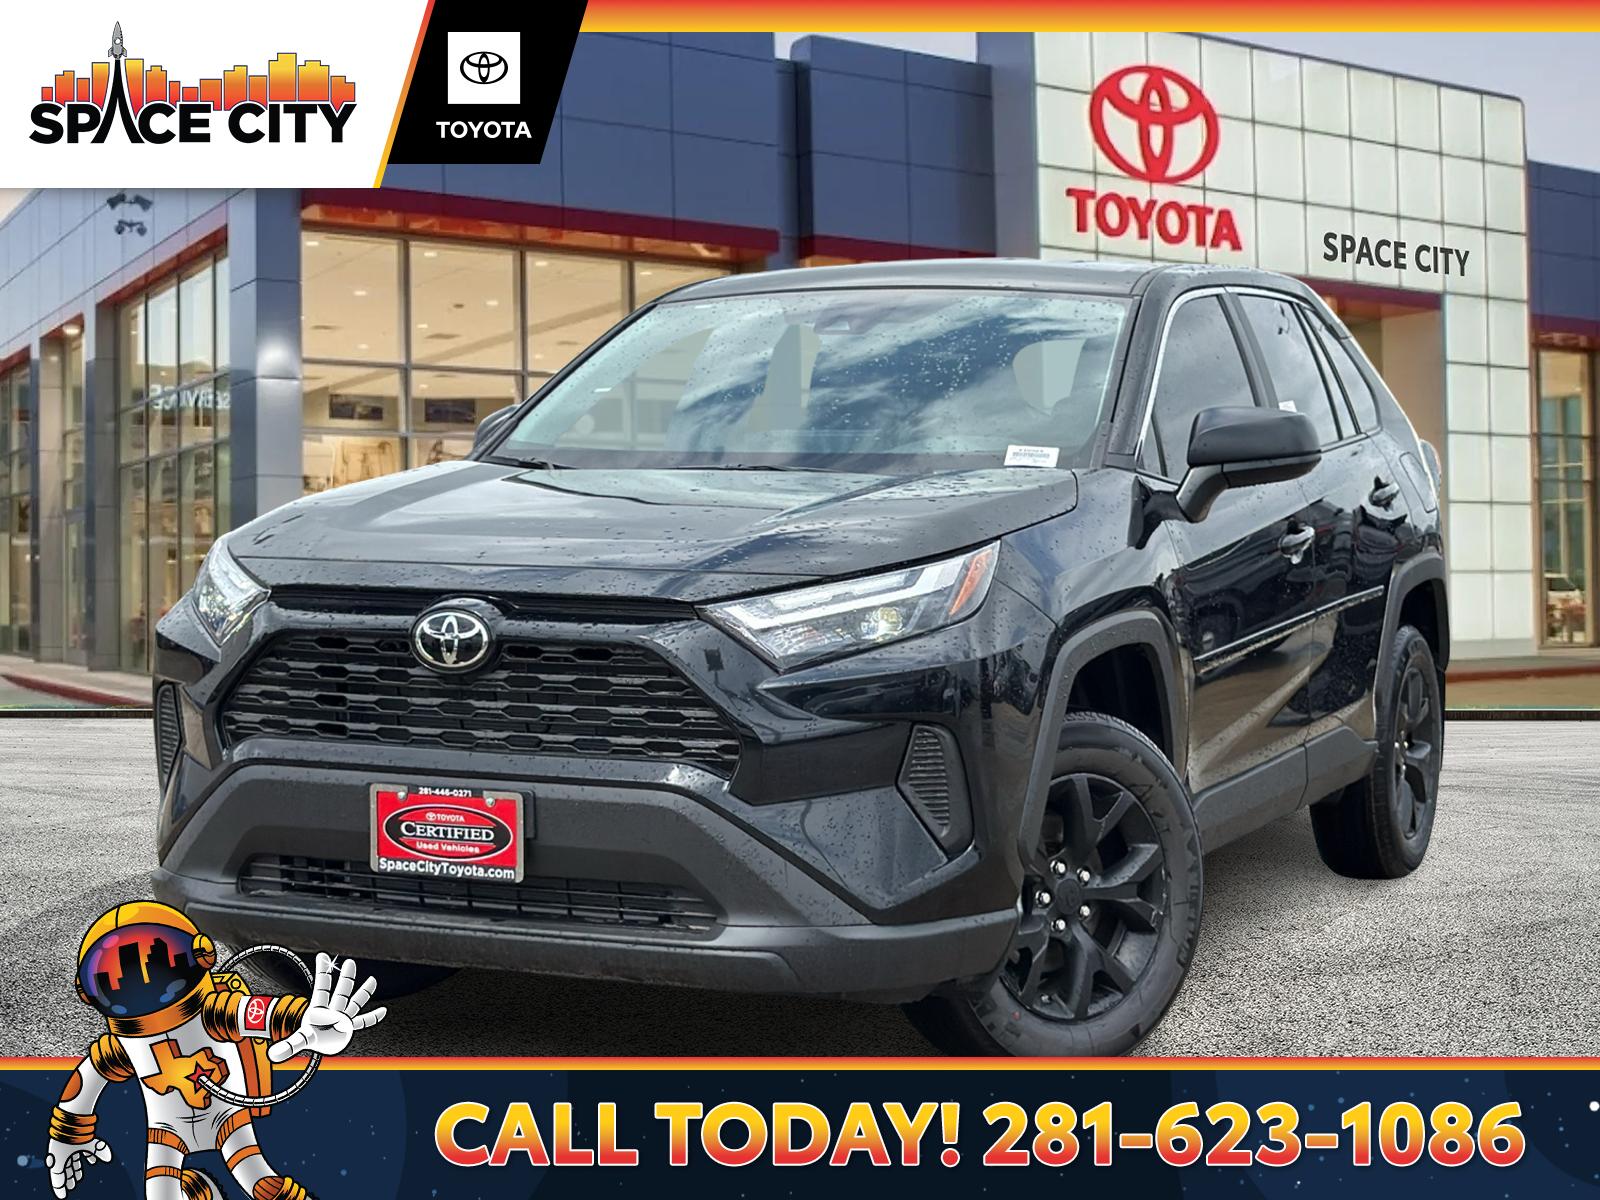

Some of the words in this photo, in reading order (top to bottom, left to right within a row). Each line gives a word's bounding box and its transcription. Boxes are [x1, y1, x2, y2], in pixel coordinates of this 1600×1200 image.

[1065, 187, 1242, 251] TOYOTA
[1322, 231, 1408, 270] SPACE
[1414, 244, 1471, 277] CITY
[437, 813, 465, 822] TOYOTA
[400, 821, 495, 841] CERTIFIED
[416, 841, 439, 851] Used
[441, 842, 480, 854] Vehicles
[379, 857, 515, 879] SpaceCityToyota.com
